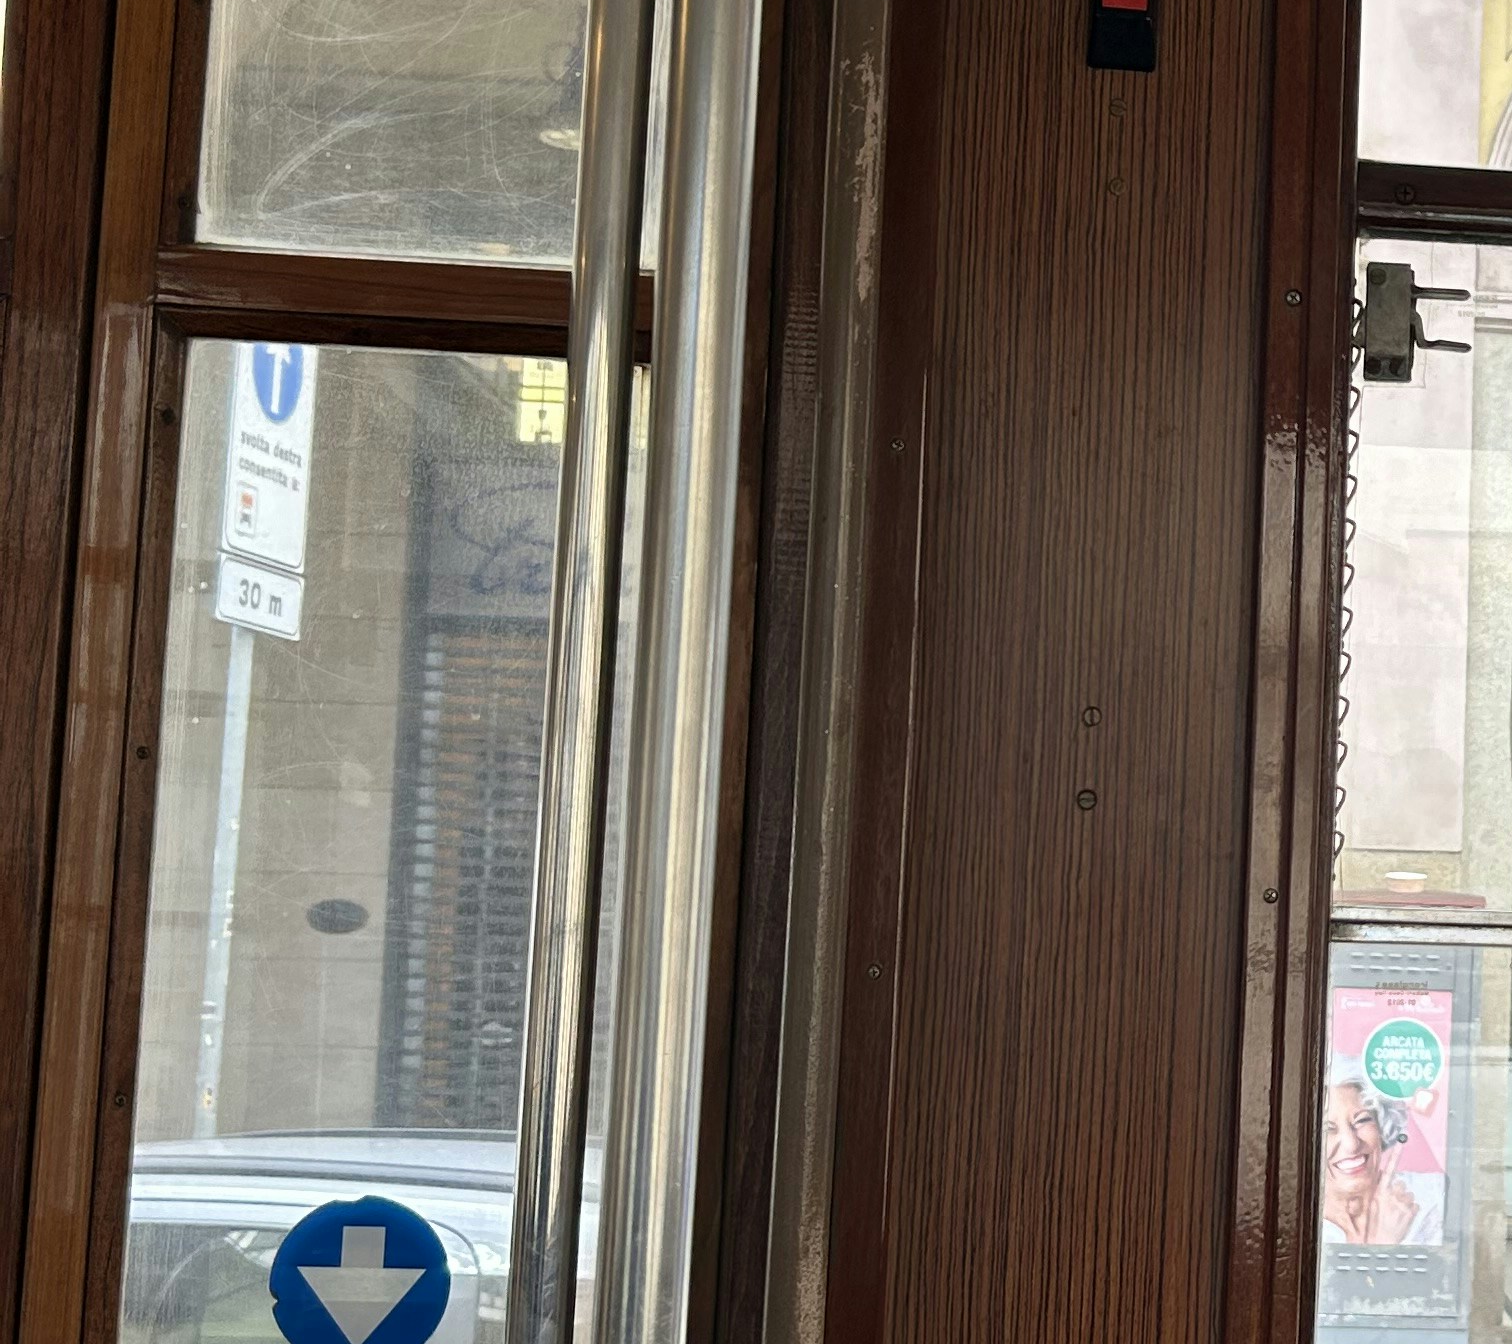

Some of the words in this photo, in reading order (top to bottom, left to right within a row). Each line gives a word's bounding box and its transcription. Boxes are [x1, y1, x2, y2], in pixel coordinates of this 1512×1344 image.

[240, 431, 270, 455] svolta
[273, 441, 302, 468] destra
[239, 579, 261, 610] 30
[268, 594, 282, 617] m
[1373, 1047, 1433, 1062] COMPLETA
[1381, 1035, 1426, 1049] ARCATA
